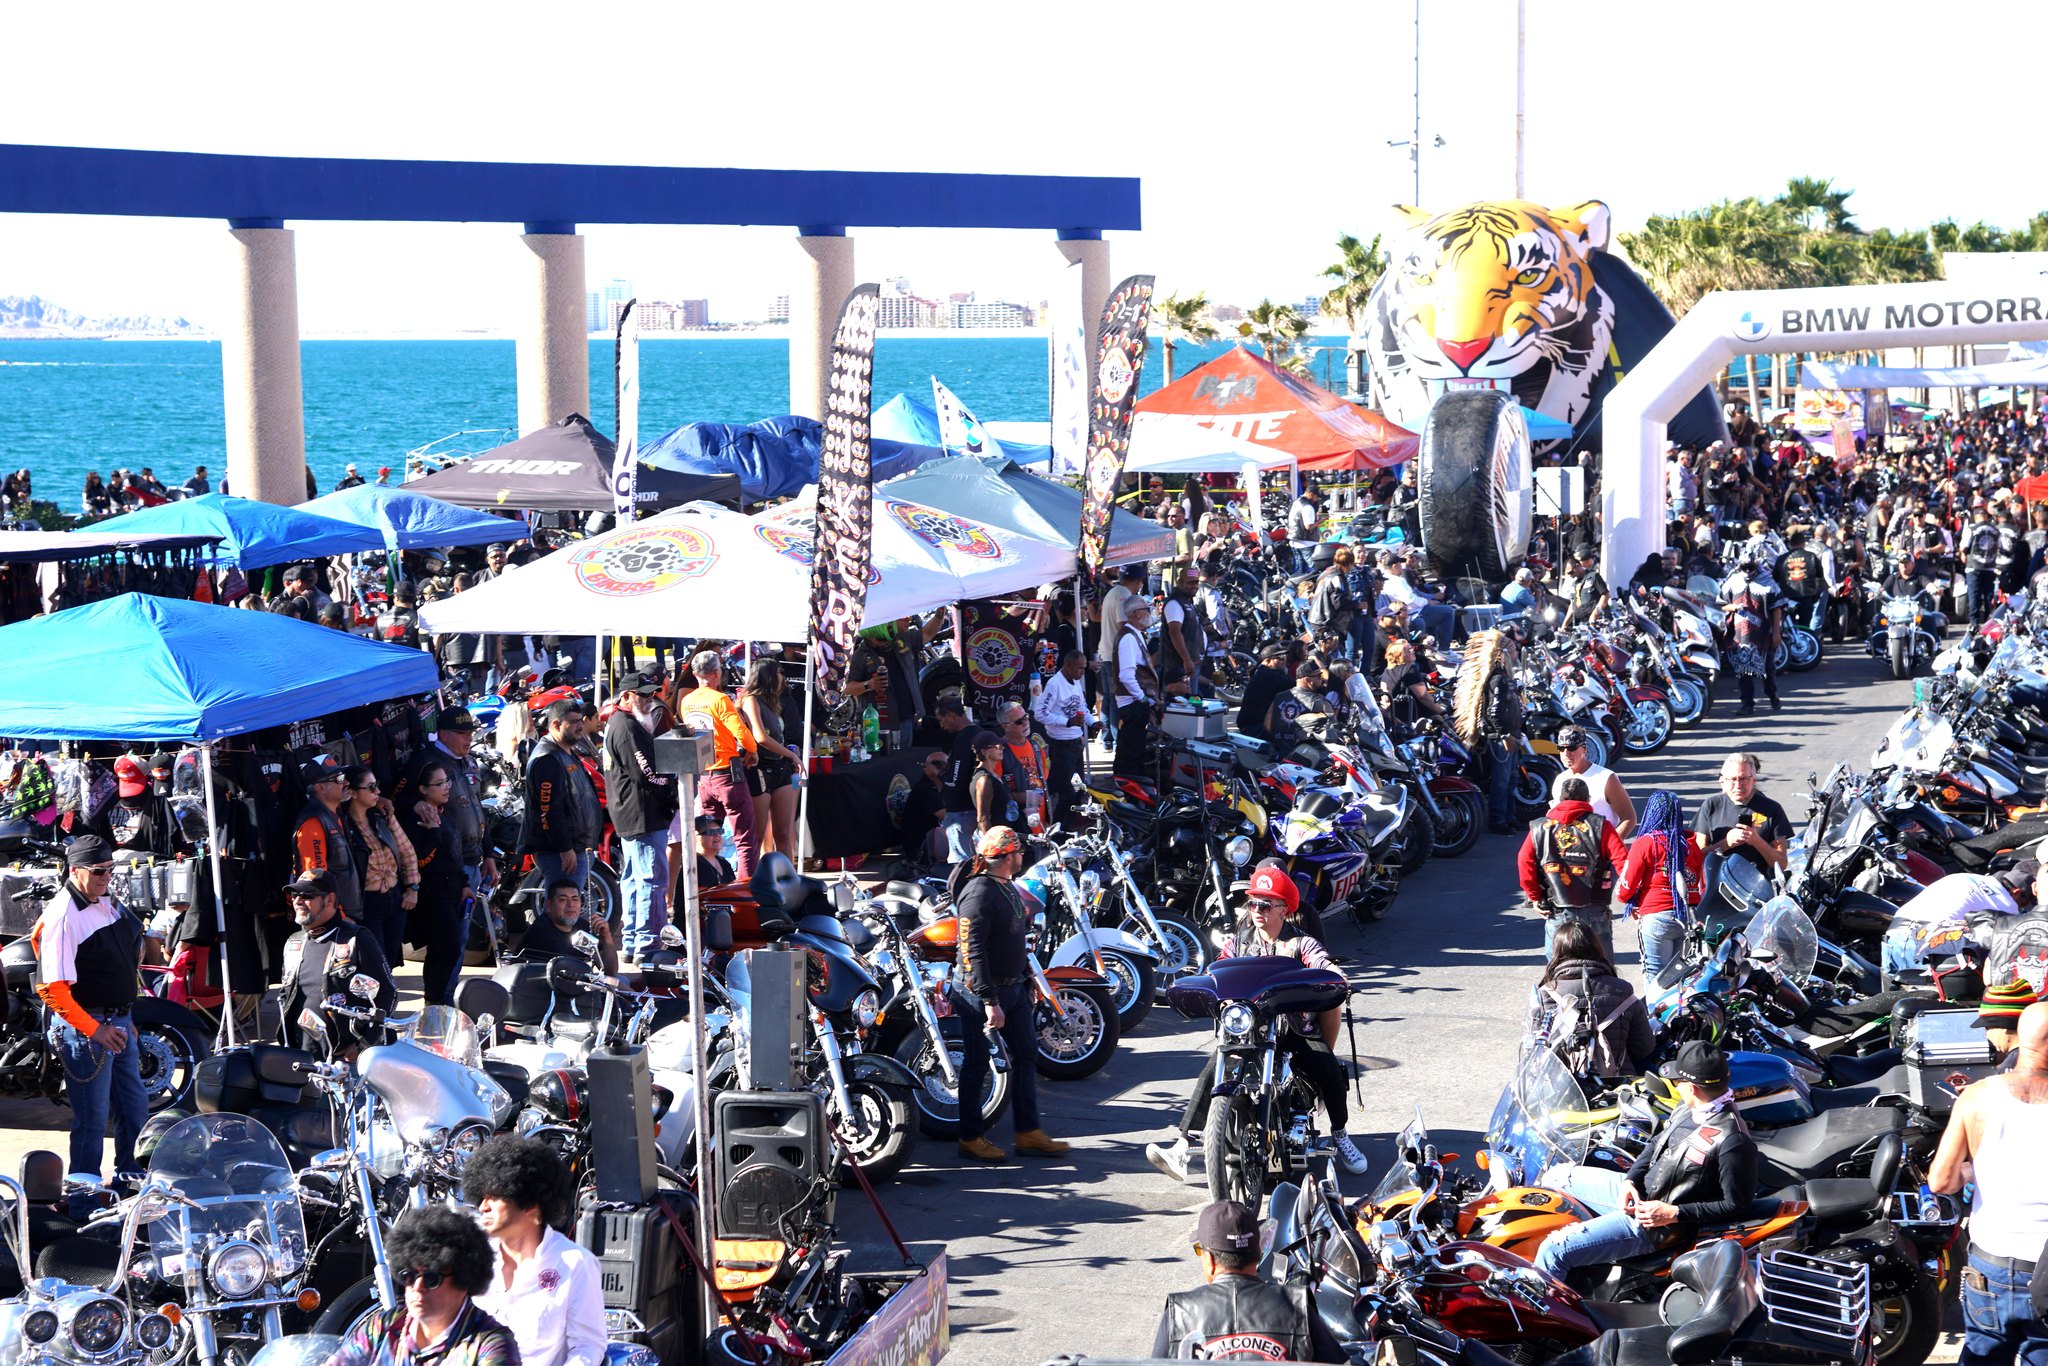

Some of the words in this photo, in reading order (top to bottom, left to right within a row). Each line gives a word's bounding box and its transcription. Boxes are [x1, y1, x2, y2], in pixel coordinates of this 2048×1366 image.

[1782, 306, 1871, 333] BMW
[1885, 297, 2048, 329] MOTORR
[466, 458, 584, 476] THOR
[634, 491, 659, 502] HOR
[585, 572, 657, 593] BIKERS
[1332, 866, 1364, 903] FIAT
[909, 1292, 941, 1359] PARTY
[1205, 1336, 1282, 1358] ALCONES
